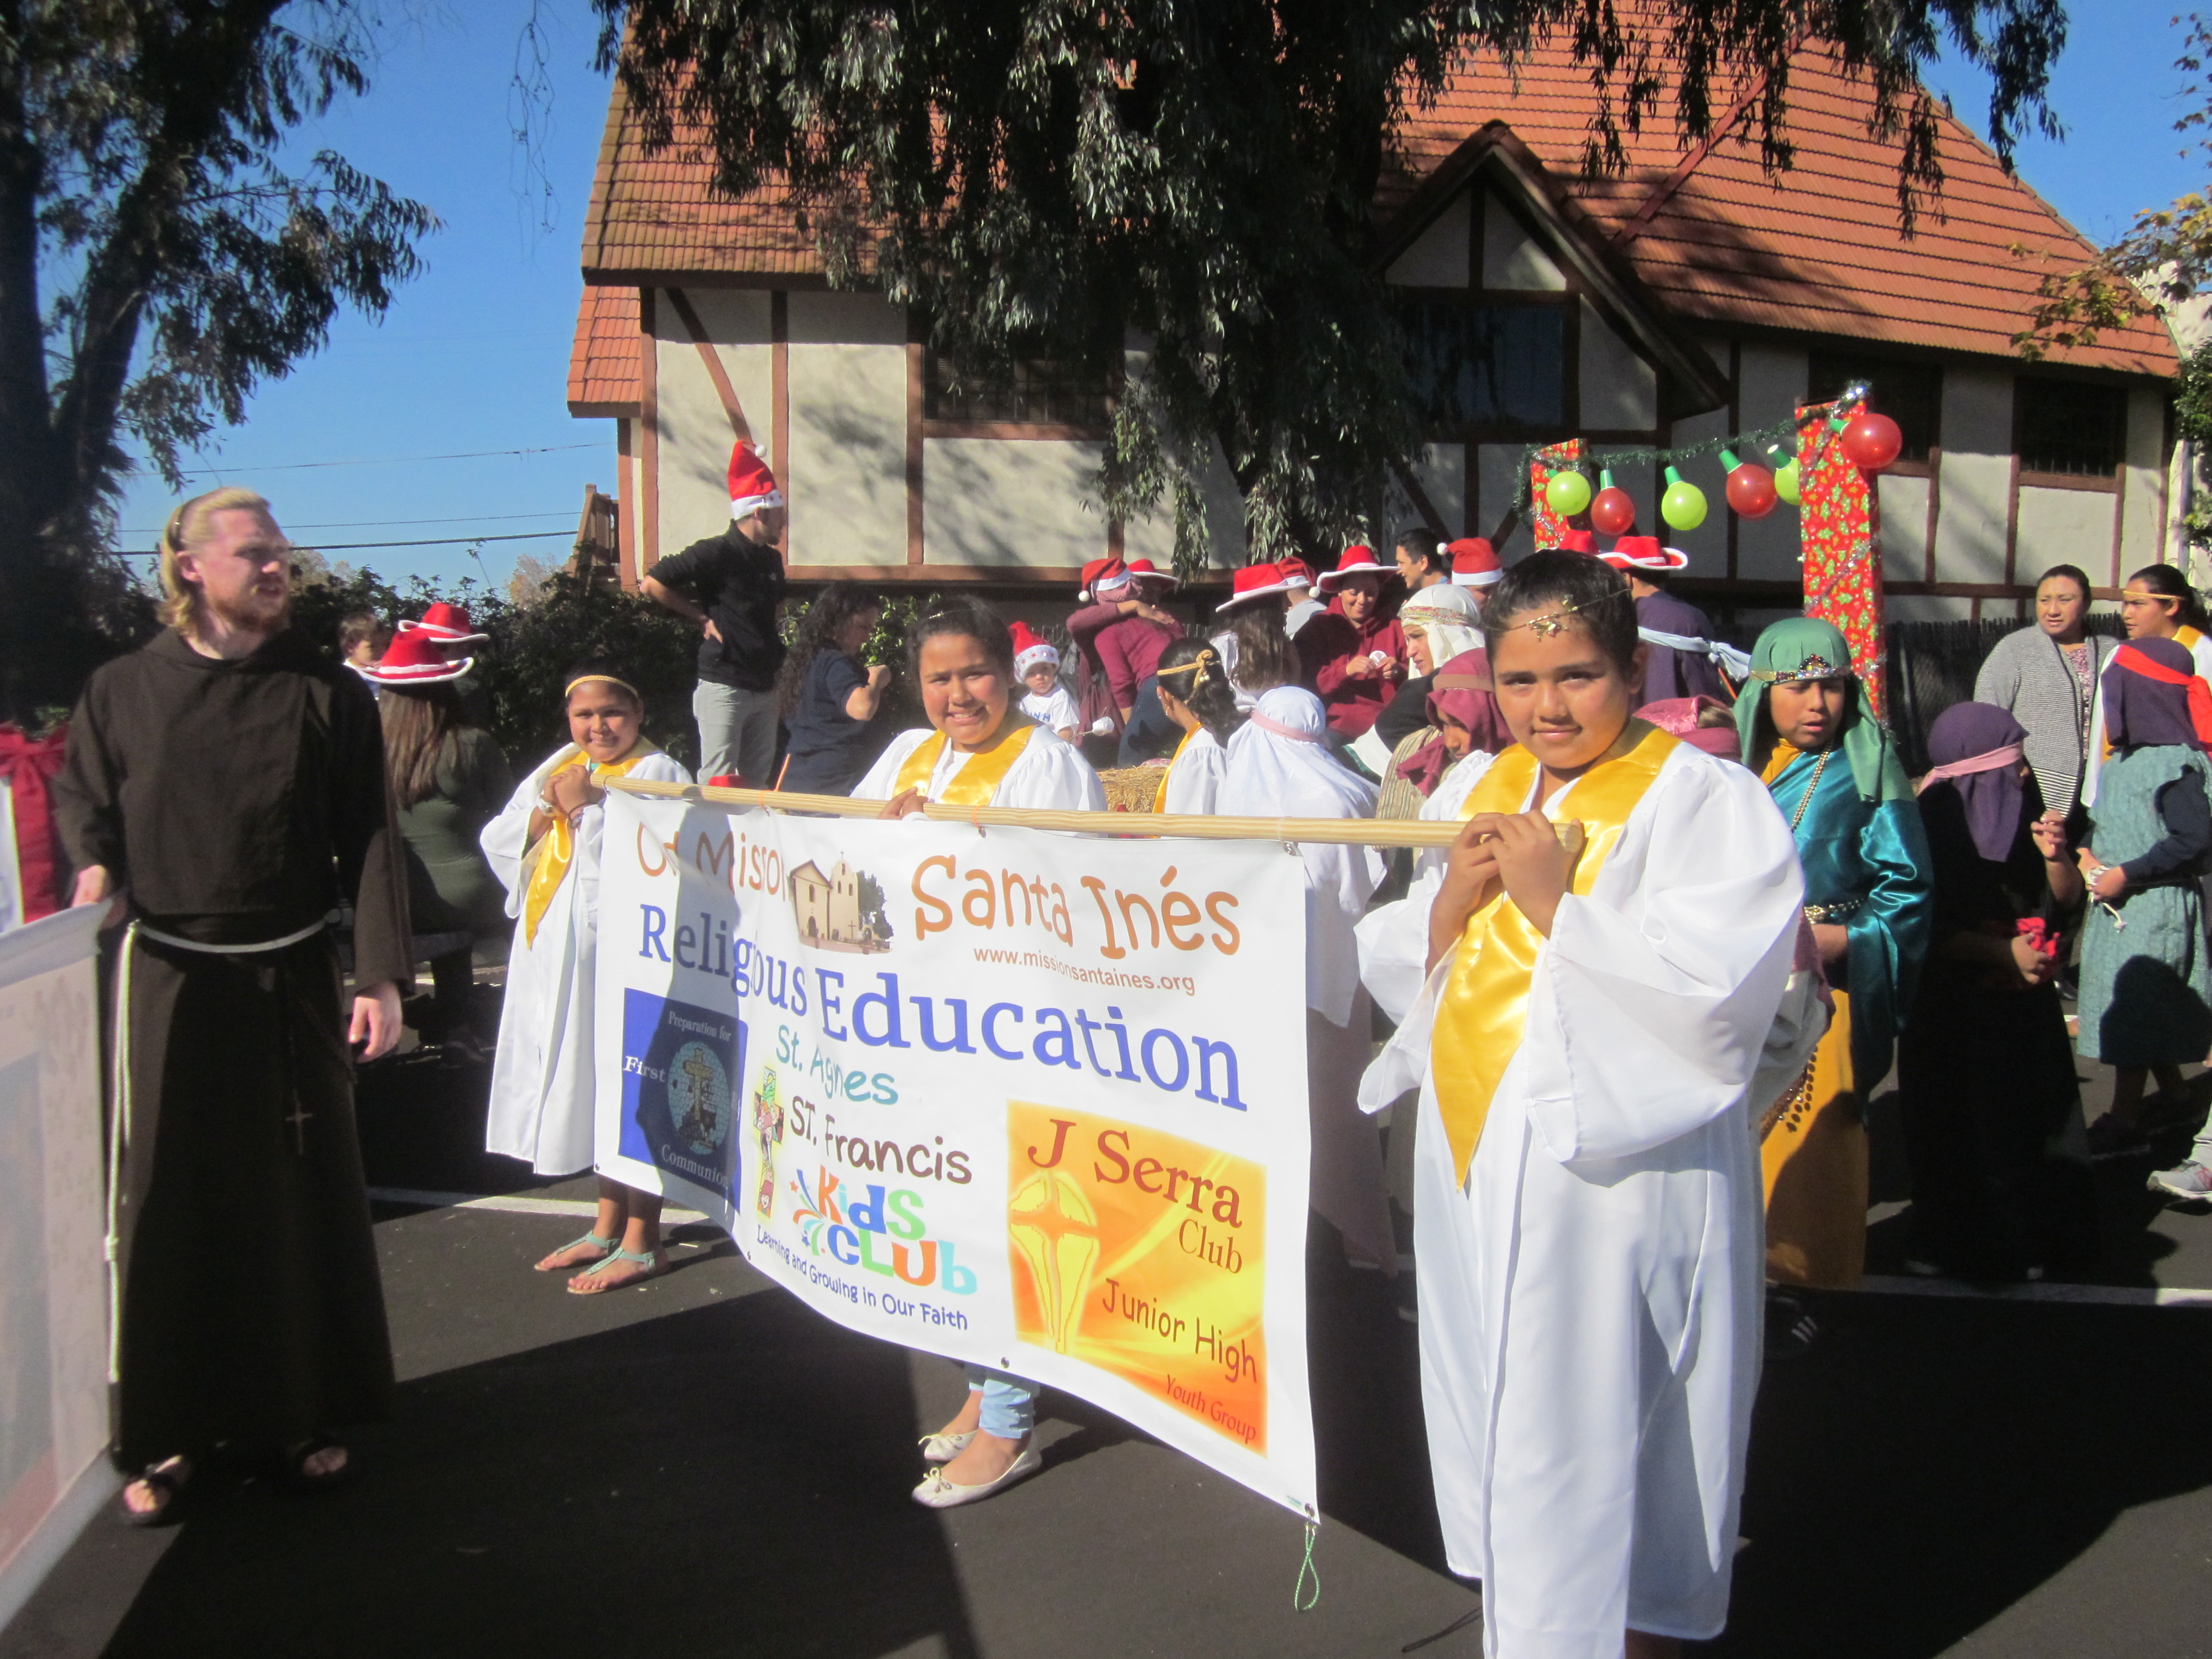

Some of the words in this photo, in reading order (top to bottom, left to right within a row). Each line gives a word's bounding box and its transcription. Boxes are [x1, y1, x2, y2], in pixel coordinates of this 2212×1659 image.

[911, 854, 1074, 947] Santa
[1080, 865, 1240, 959] Inés
[973, 947, 1196, 997] www.missionsantaines.org
[669, 1011, 717, 1037] Preparation
[719, 1025, 732, 1042] for
[815, 967, 1248, 1112] Education
[623, 1055, 667, 1082] First
[776, 1024, 803, 1072] St.
[810, 1044, 899, 1105] Agnes
[662, 1144, 728, 1190] Communion
[825, 1114, 972, 1185] Francis
[1027, 1118, 1077, 1168] J
[1094, 1130, 1243, 1228] Serra
[757, 1224, 790, 1265] Learning
[792, 1253, 807, 1276] and
[810, 1264, 858, 1303] Growing
[862, 1286, 877, 1307] in
[882, 1293, 916, 1317] Our
[920, 1303, 968, 1330] Faith
[1179, 1219, 1243, 1274] Club
[1102, 1278, 1186, 1343] Junior
[1195, 1317, 1258, 1383] High
[1166, 1374, 1206, 1413] Youth
[1211, 1396, 1257, 1444] Group
